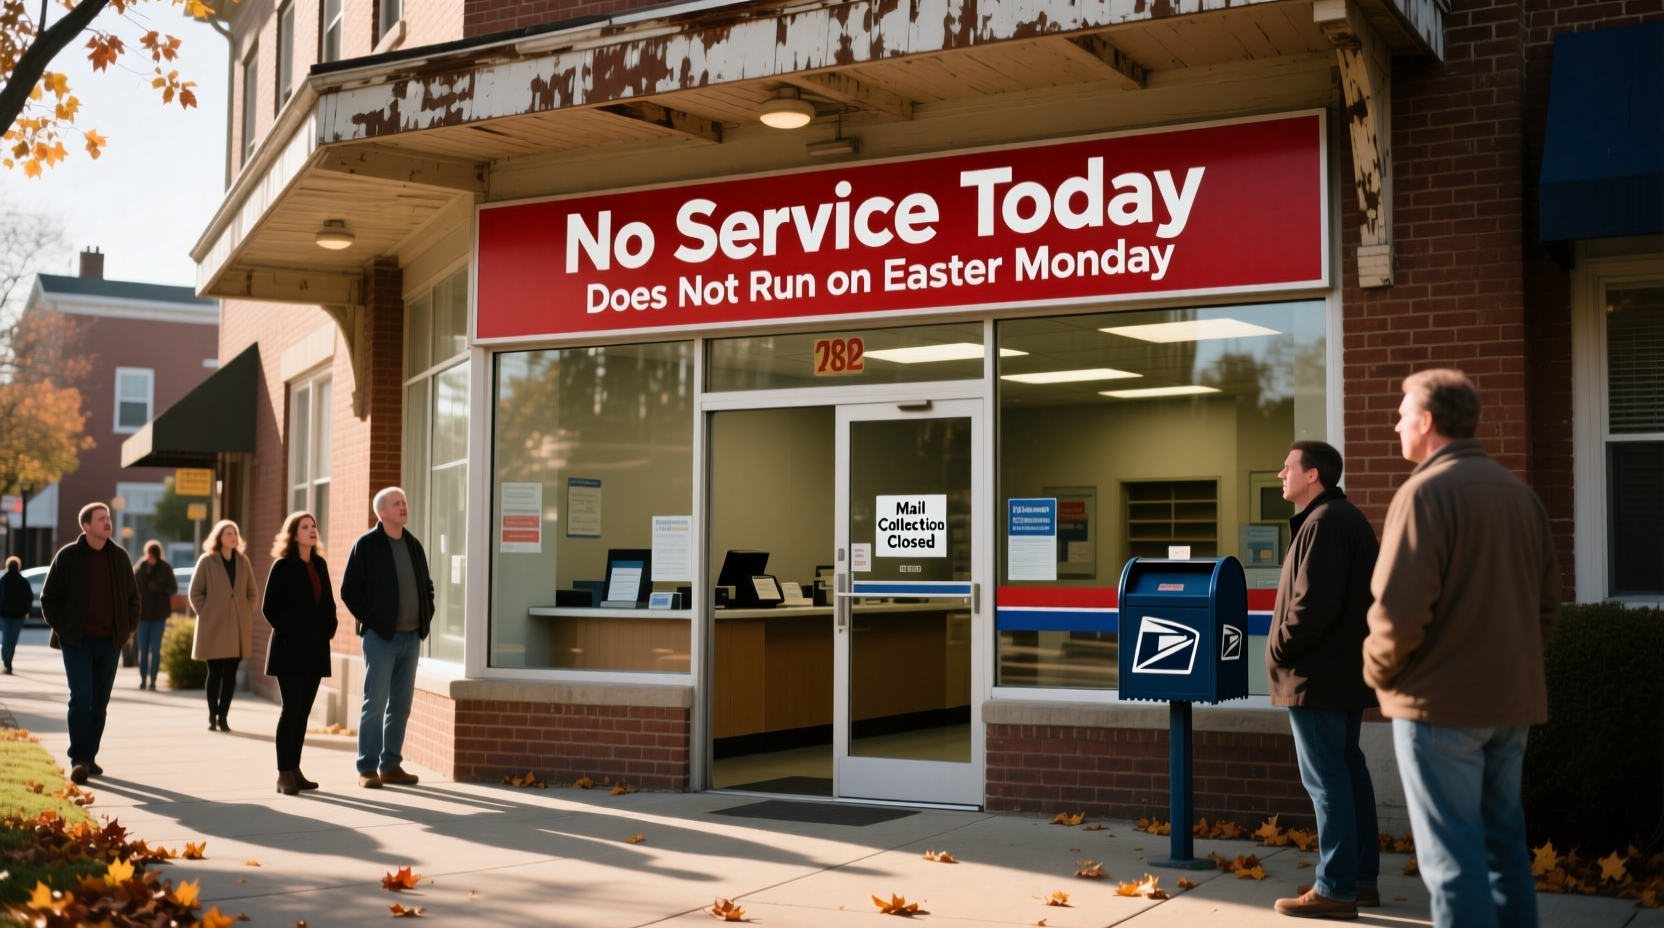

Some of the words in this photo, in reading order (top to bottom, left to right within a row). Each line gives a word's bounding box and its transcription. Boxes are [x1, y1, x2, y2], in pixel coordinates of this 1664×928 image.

[566, 211, 654, 273] No
[674, 181, 939, 263] Service
[961, 157, 1205, 238] Today
[587, 281, 668, 314] Does
[679, 274, 739, 308] Not
[750, 270, 816, 302] Run
[827, 270, 871, 296] on
[885, 254, 1003, 292] Easter
[1016, 239, 1175, 281] Monday
[815, 337, 864, 372] 782
[896, 500, 926, 516] Mail
[878, 517, 945, 532] Collection
[887, 533, 935, 549] Closed
